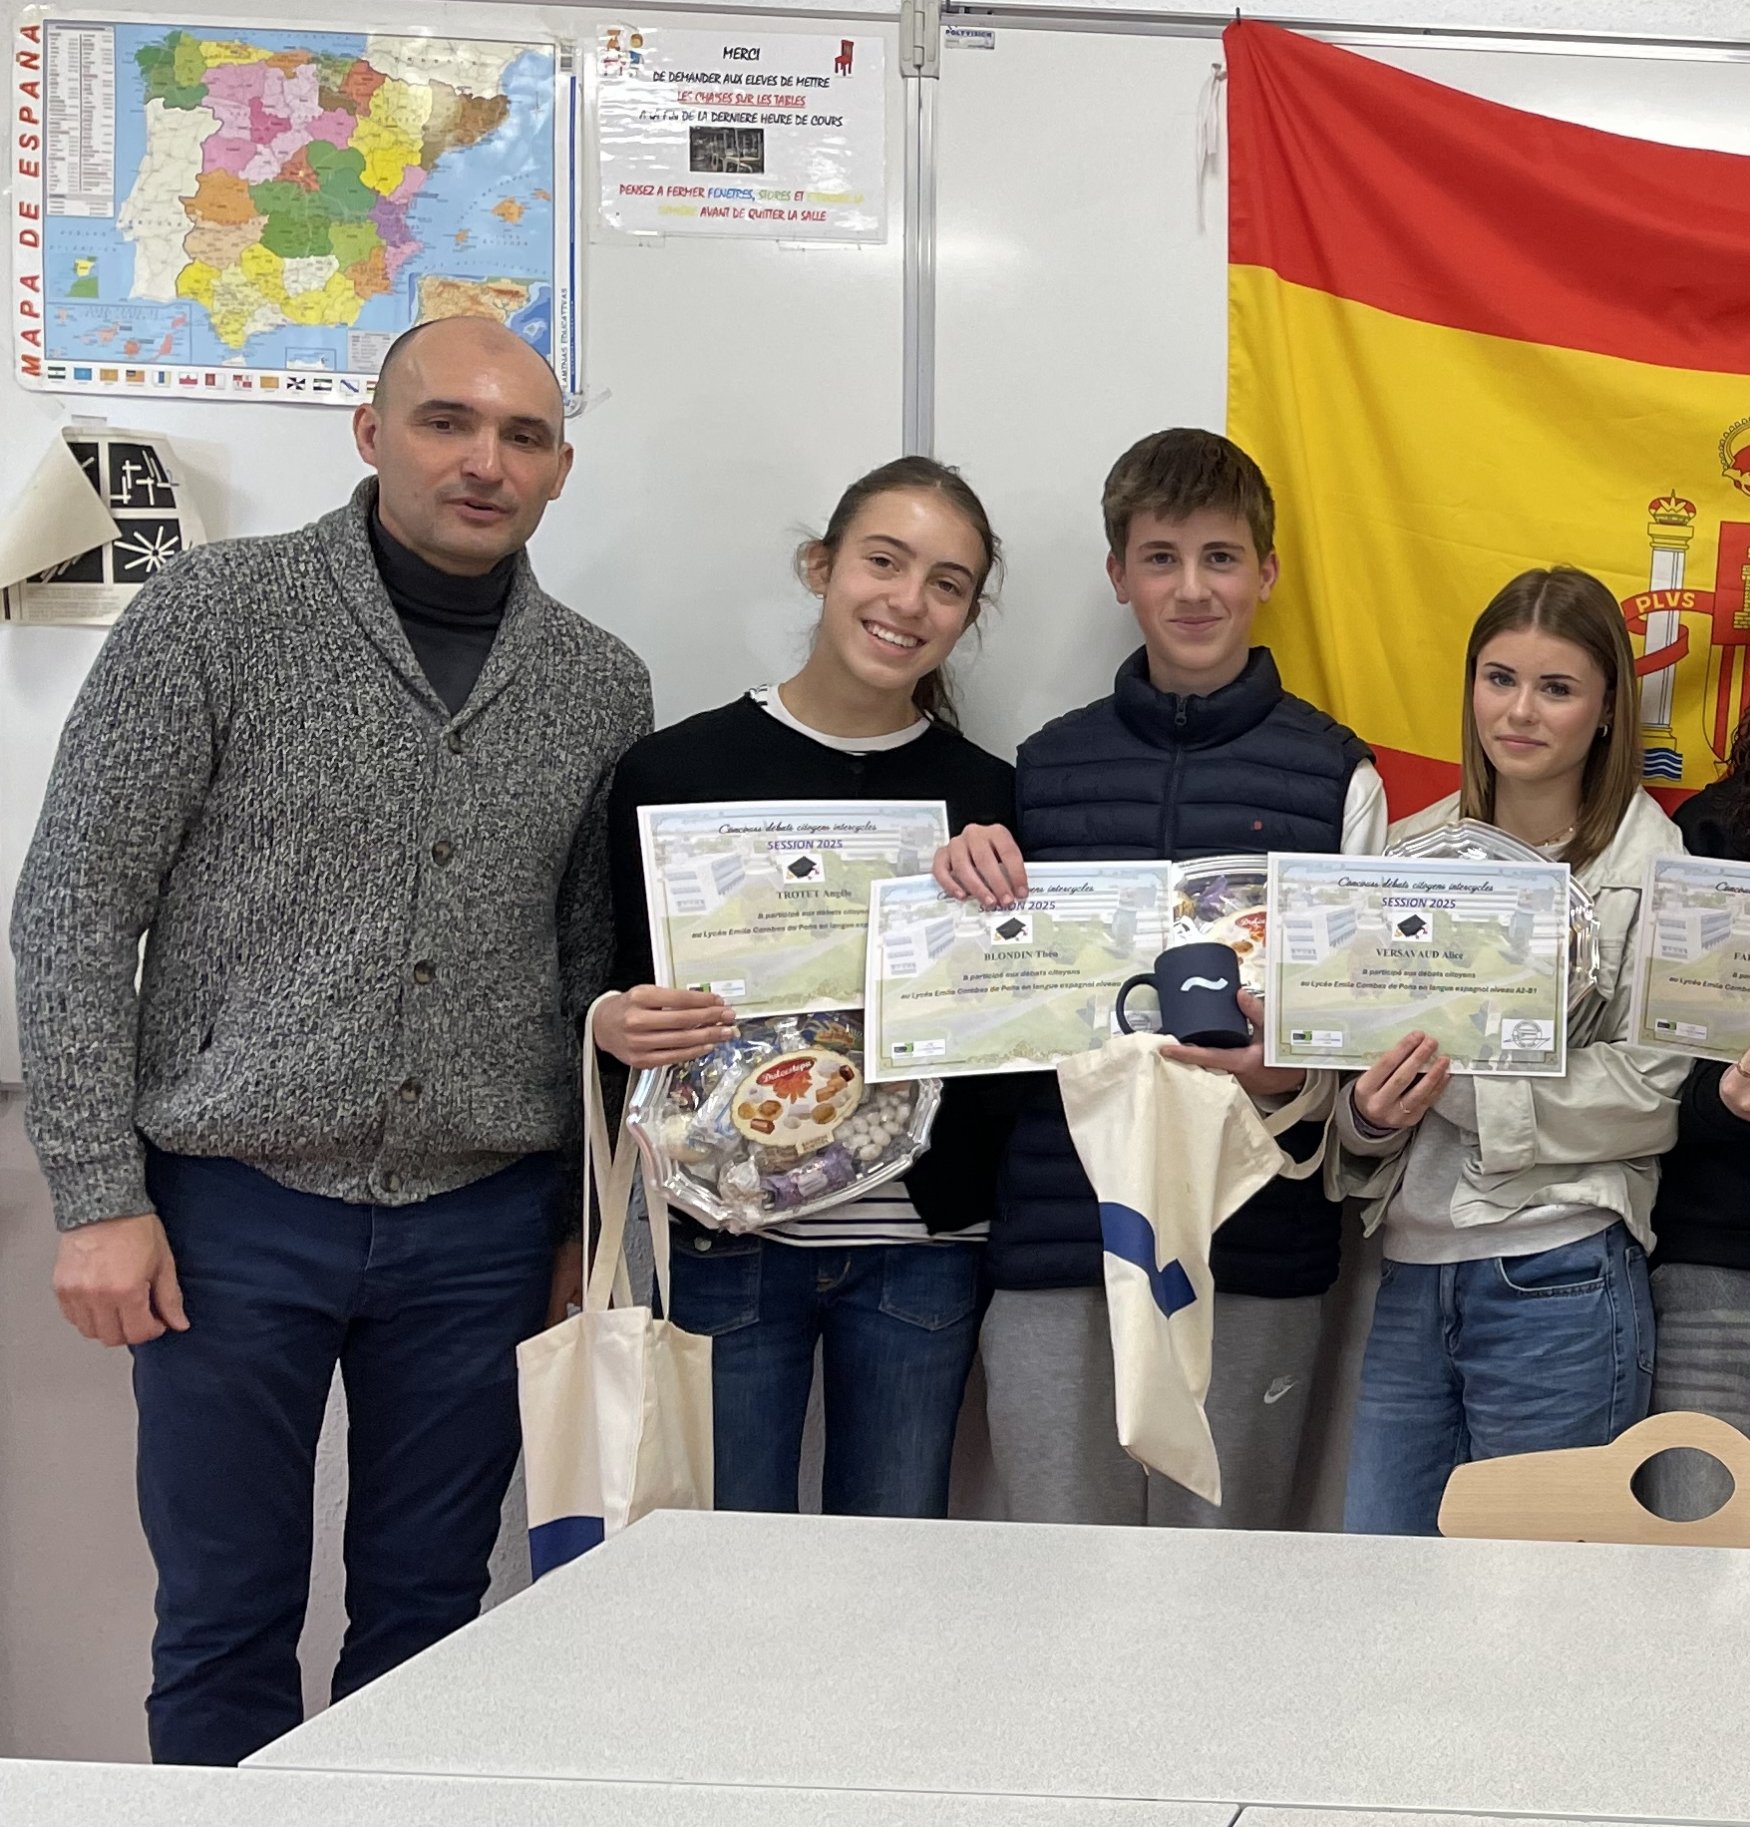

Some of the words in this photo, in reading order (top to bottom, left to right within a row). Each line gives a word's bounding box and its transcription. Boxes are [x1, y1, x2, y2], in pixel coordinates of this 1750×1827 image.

[723, 47, 760, 61] MERCI
[653, 71, 666, 82] DE
[669, 71, 721, 84] DEMANDER
[723, 73, 742, 85] AUX
[746, 74, 778, 86] ELEVES
[781, 75, 794, 86] DE
[796, 77, 830, 88] METTRE
[17, 23, 42, 177] ESPAÑA
[736, 94, 754, 105] SUR
[757, 95, 772, 106] LES
[774, 95, 806, 106] TABLES
[682, 110, 694, 122] DE
[698, 110, 708, 122] LA
[711, 111, 758, 124] DERNIERE
[761, 112, 792, 124] HEURE
[796, 114, 808, 125] DE
[810, 115, 842, 127] COURS
[620, 184, 654, 196] PENSEZ
[656, 186, 664, 196] A
[666, 186, 704, 198] FERMER
[794, 190, 804, 202] ET
[700, 207, 730, 218] AVANT
[732, 208, 745, 219] DE
[748, 208, 786, 221] QUITTER
[788, 210, 798, 221] LA
[801, 210, 827, 222] SALLE
[18, 201, 41, 249] DE
[20, 274, 43, 377] MAPA
[1636, 591, 1696, 613] PLVS
[767, 839, 813, 849] SESSION
[816, 839, 842, 848] 2025
[1028, 899, 1055, 910] 2025
[1382, 897, 1427, 908] SESSION
[1429, 898, 1456, 909] 2025
[984, 951, 1032, 960] BLONDIN
[1441, 951, 1463, 959] Alice
